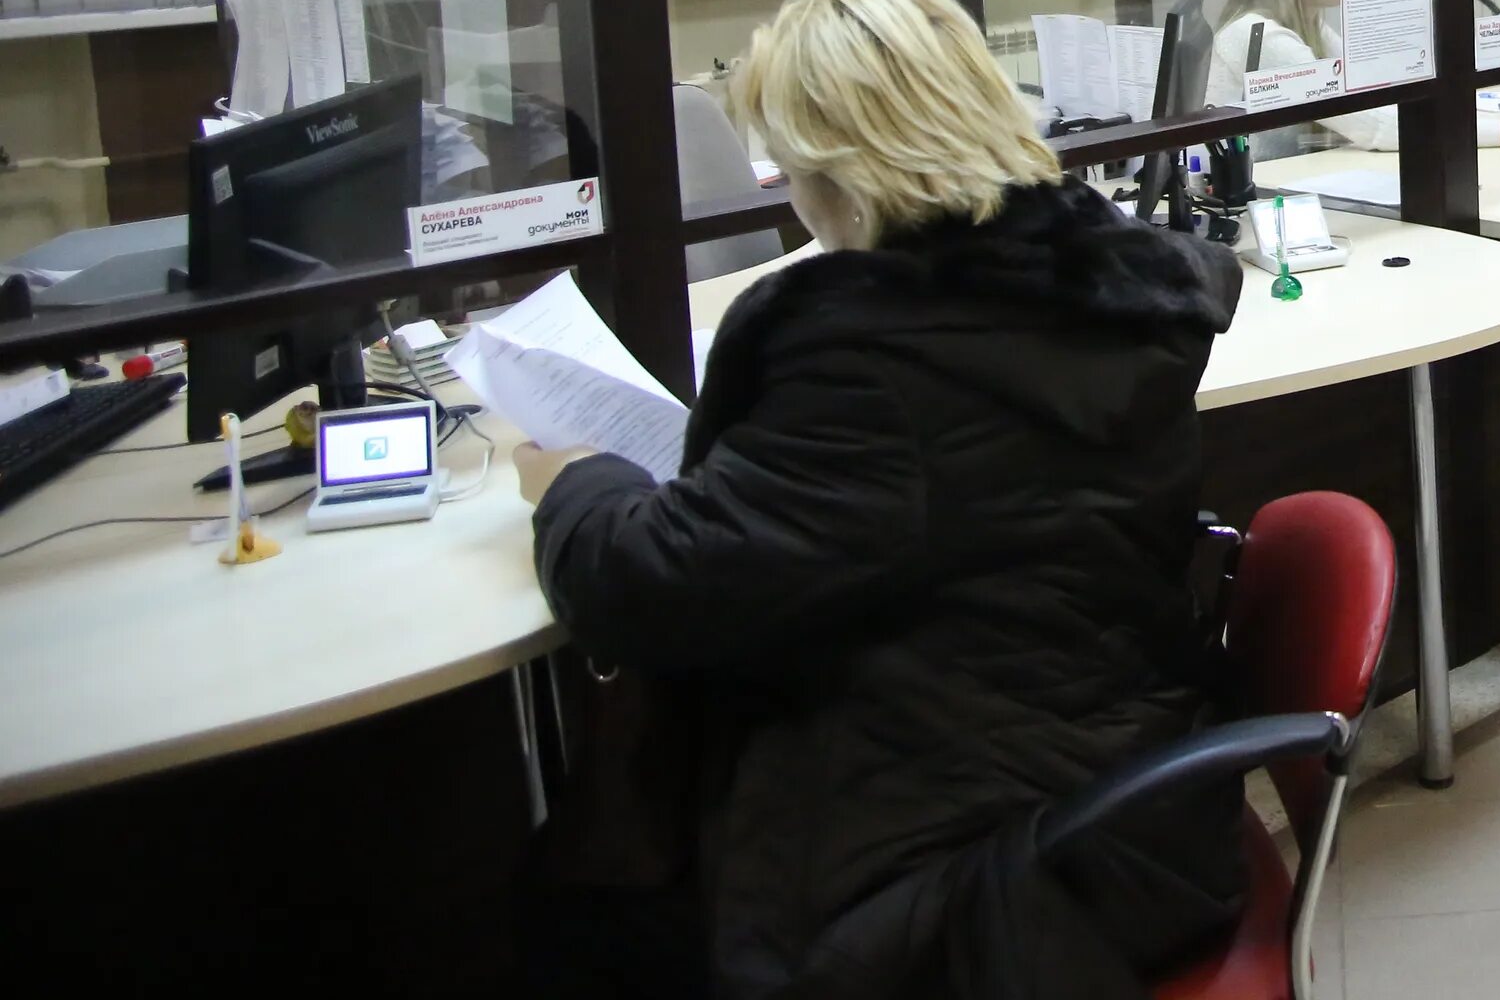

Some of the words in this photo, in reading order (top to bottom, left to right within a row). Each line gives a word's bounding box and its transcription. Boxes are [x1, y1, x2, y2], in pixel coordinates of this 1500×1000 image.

[1249, 75, 1273, 86] Марина
[1274, 68, 1316, 82] Вячеславовна
[1249, 83, 1280, 95] БЕЛКИНА
[305, 112, 359, 144] ViewSonic
[458, 194, 544, 217] Александровна
[421, 215, 483, 234] СУХАРЕВА
[528, 217, 590, 237] документы
